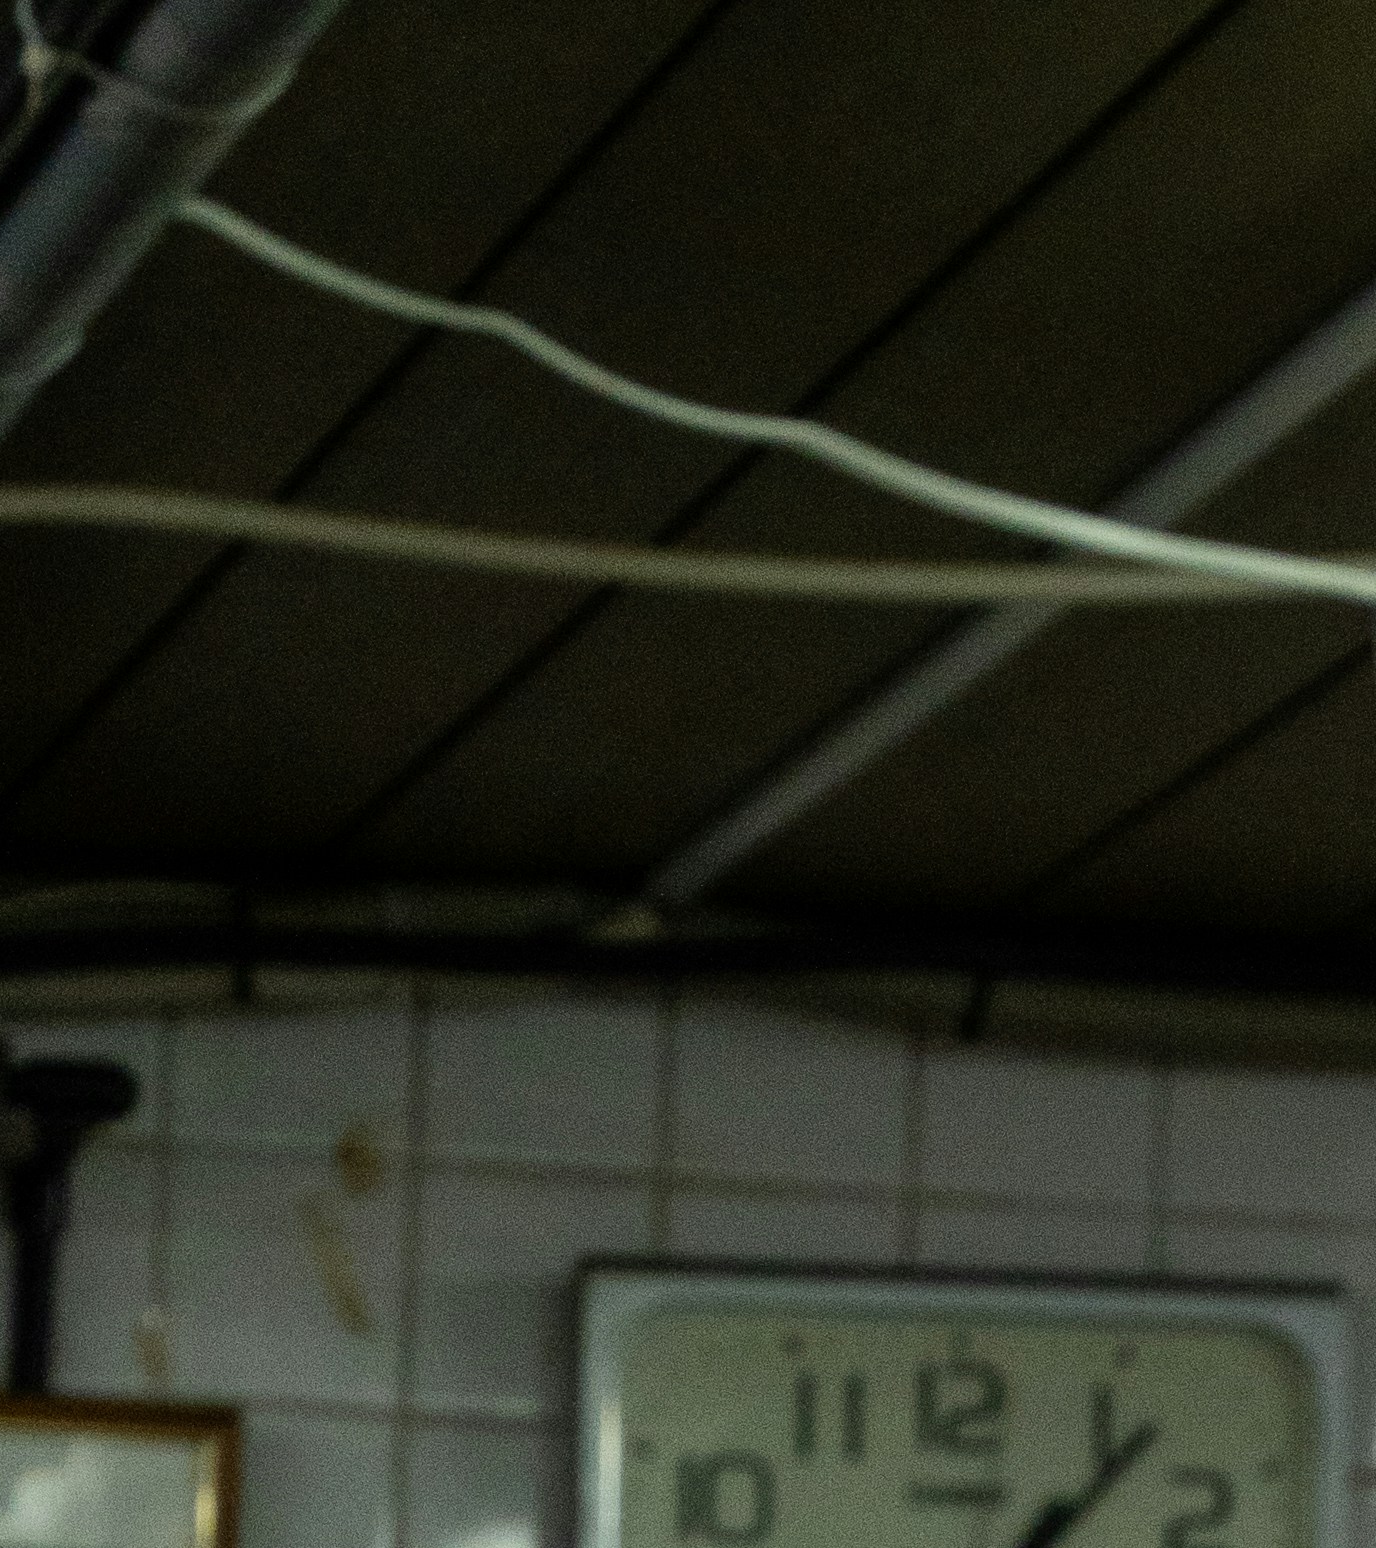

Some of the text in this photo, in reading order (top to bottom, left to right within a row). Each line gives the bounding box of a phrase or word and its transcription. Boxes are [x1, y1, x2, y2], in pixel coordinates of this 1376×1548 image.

[793, 1373, 867, 1463] 11
[914, 1358, 1009, 1456] 12
[675, 1449, 776, 1548] 10
